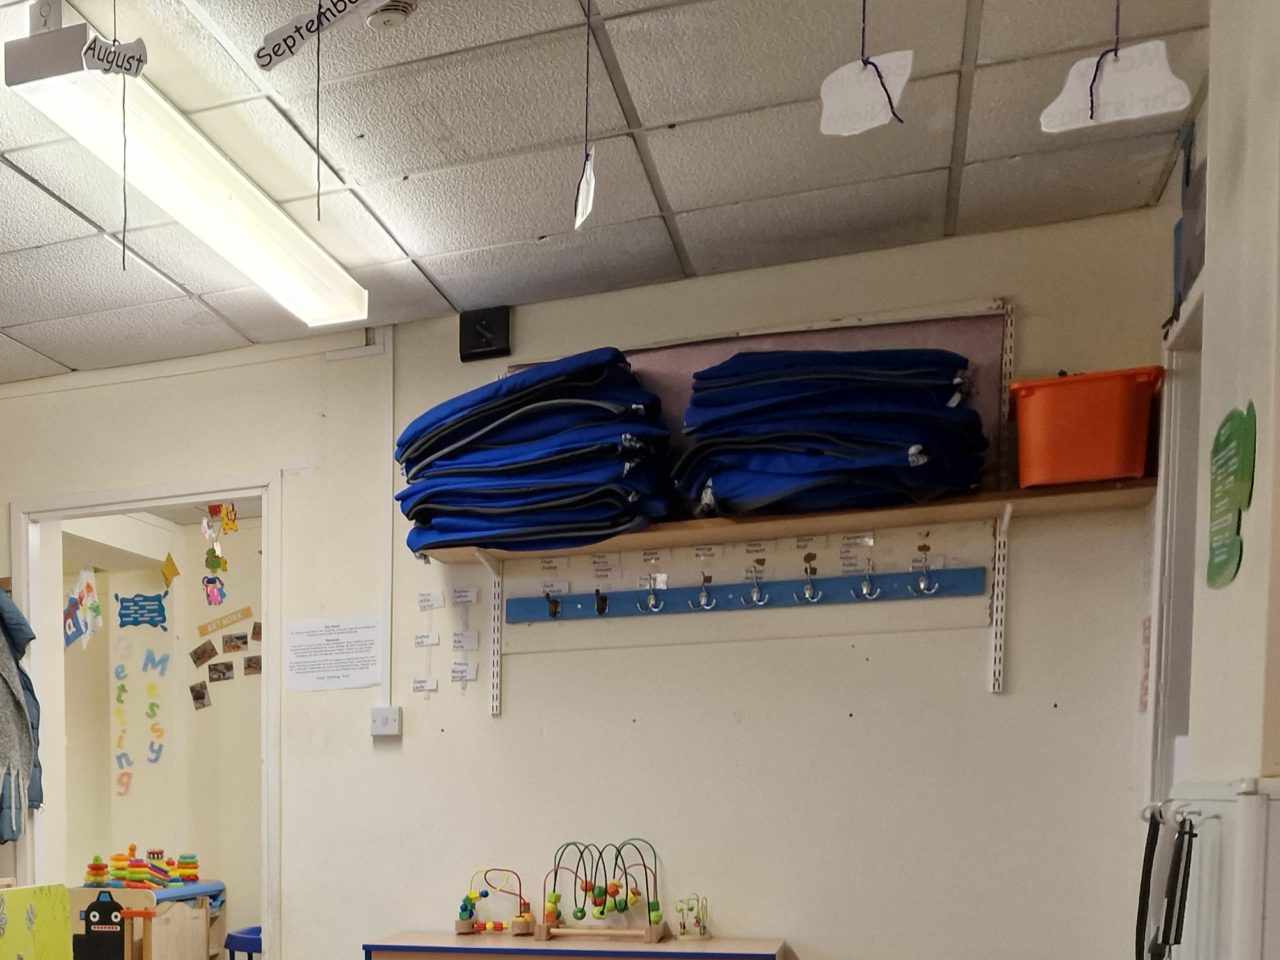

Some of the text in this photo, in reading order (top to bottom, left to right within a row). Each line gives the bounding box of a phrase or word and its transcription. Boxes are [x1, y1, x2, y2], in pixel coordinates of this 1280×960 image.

[84, 40, 144, 75] August
[256, 0, 359, 67] Septemb
[112, 636, 134, 797] eting
[142, 648, 170, 764] Mssy
